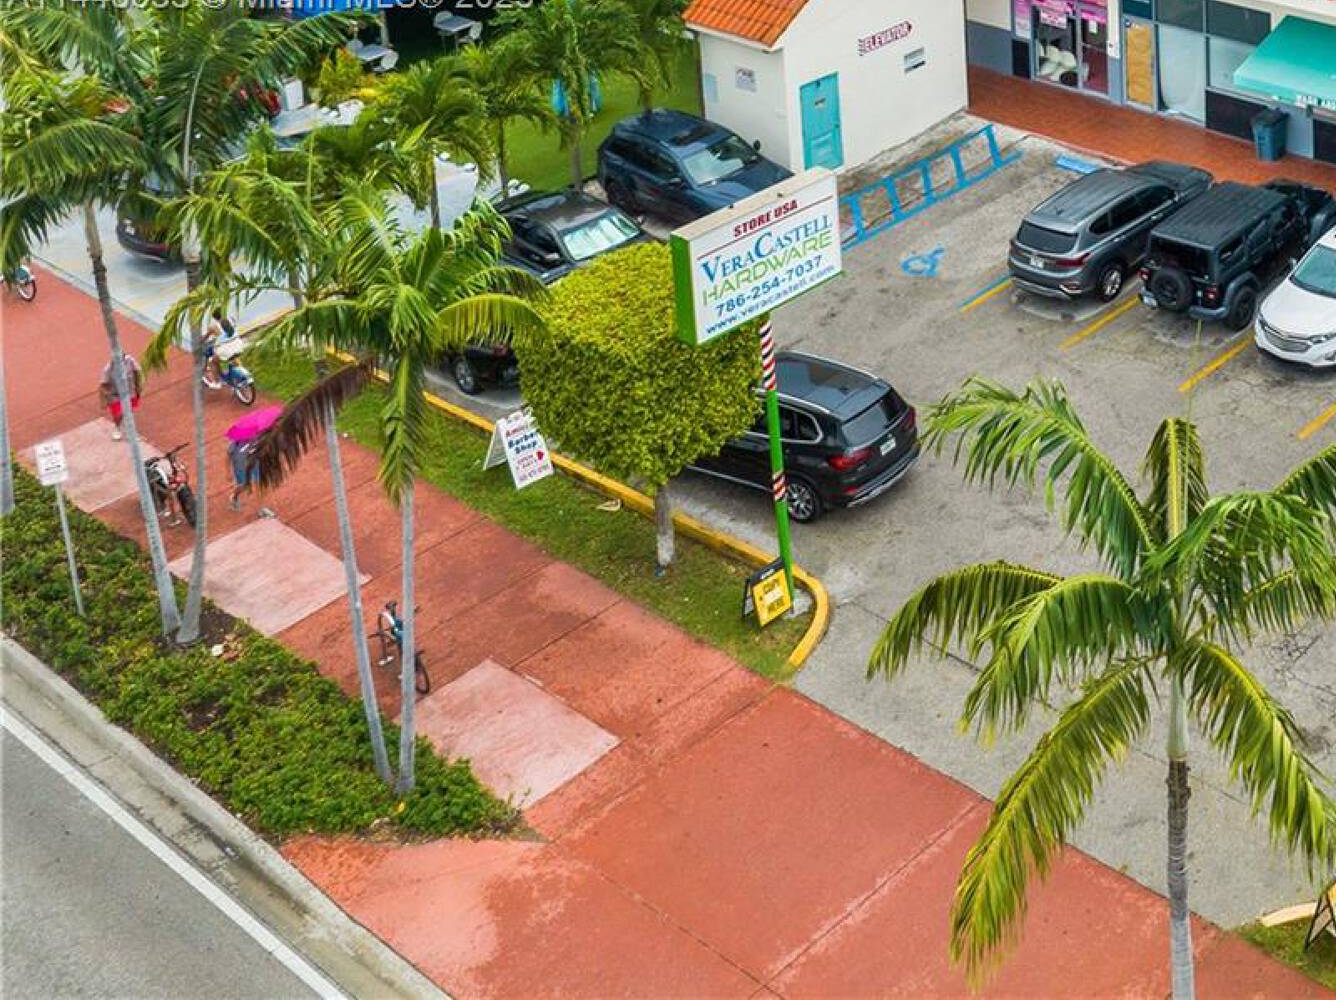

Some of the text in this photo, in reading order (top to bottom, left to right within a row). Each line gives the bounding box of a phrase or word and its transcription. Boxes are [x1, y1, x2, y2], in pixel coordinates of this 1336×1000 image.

[733, 199, 799, 237] STORE USA
[702, 229, 833, 306] HARDWARE
[714, 255, 823, 317] 786-254-7037
[507, 432, 536, 448] Barbe
